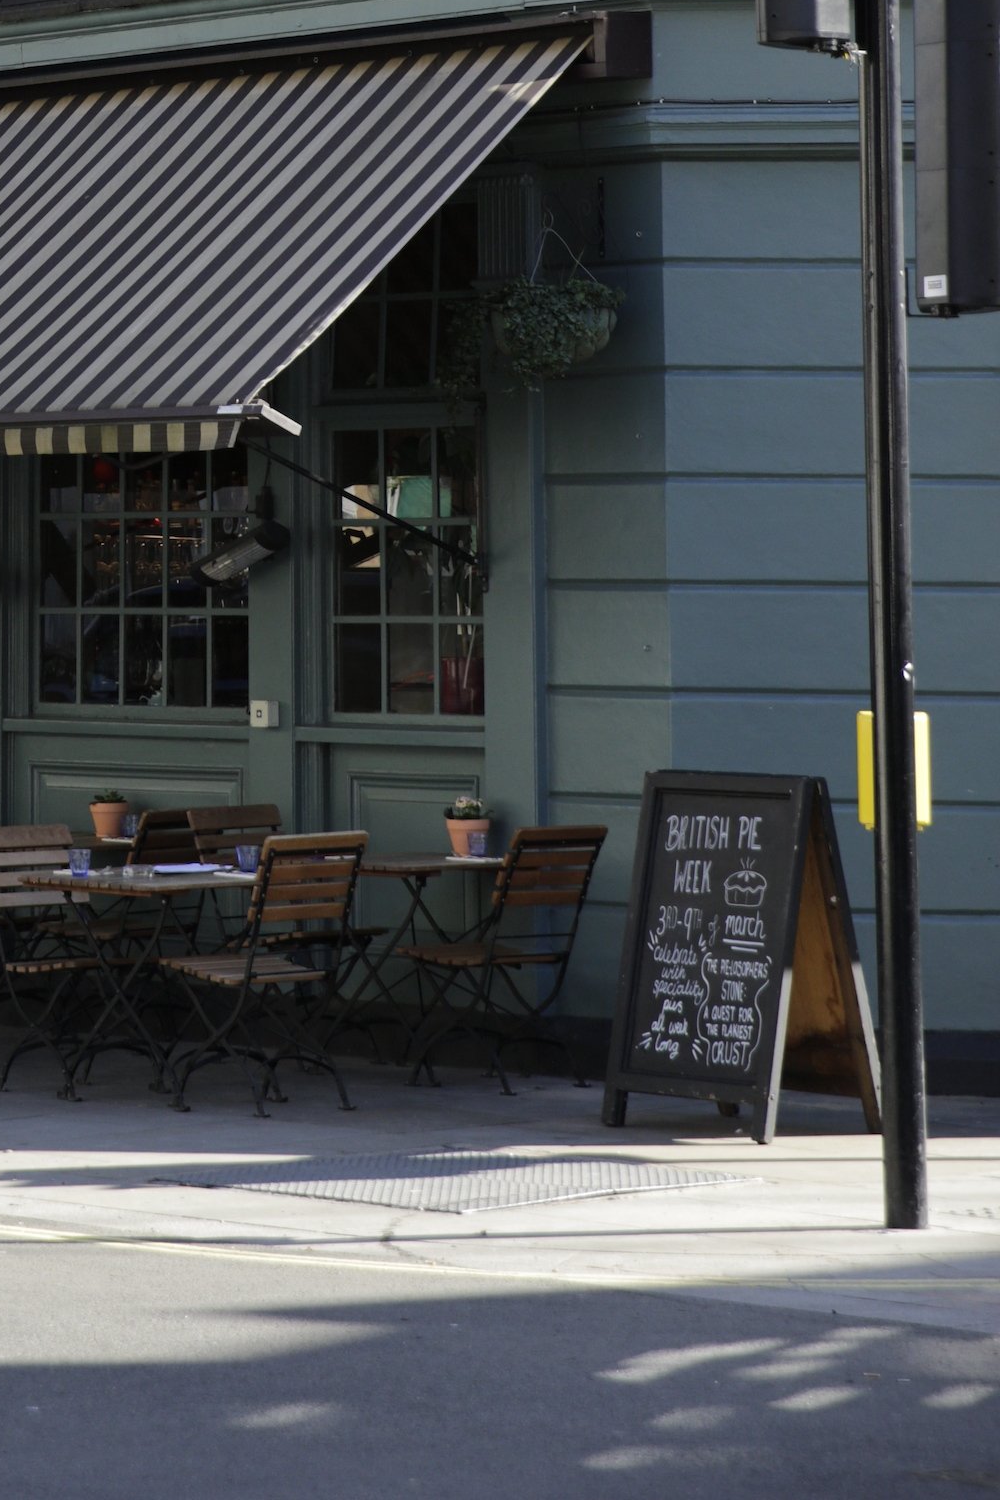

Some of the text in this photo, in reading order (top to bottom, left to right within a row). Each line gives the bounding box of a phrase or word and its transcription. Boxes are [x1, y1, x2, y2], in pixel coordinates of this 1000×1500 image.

[665, 815, 762, 852] BRITISH PIE
[674, 860, 712, 894] WEEK
[708, 914, 720, 946] of
[725, 911, 766, 939] march
[653, 942, 697, 965] celebrate
[662, 964, 686, 979] with
[706, 959, 718, 973] THE
[653, 980, 704, 1005] speciality
[721, 980, 747, 1002] STONE:
[662, 997, 683, 1014] pies
[703, 1006, 754, 1022] A QUEST FOR
[651, 1013, 688, 1036] all week
[706, 1025, 753, 1040] THE FLAKIEST
[655, 1034, 679, 1060] long
[711, 1041, 750, 1065] CRUST
